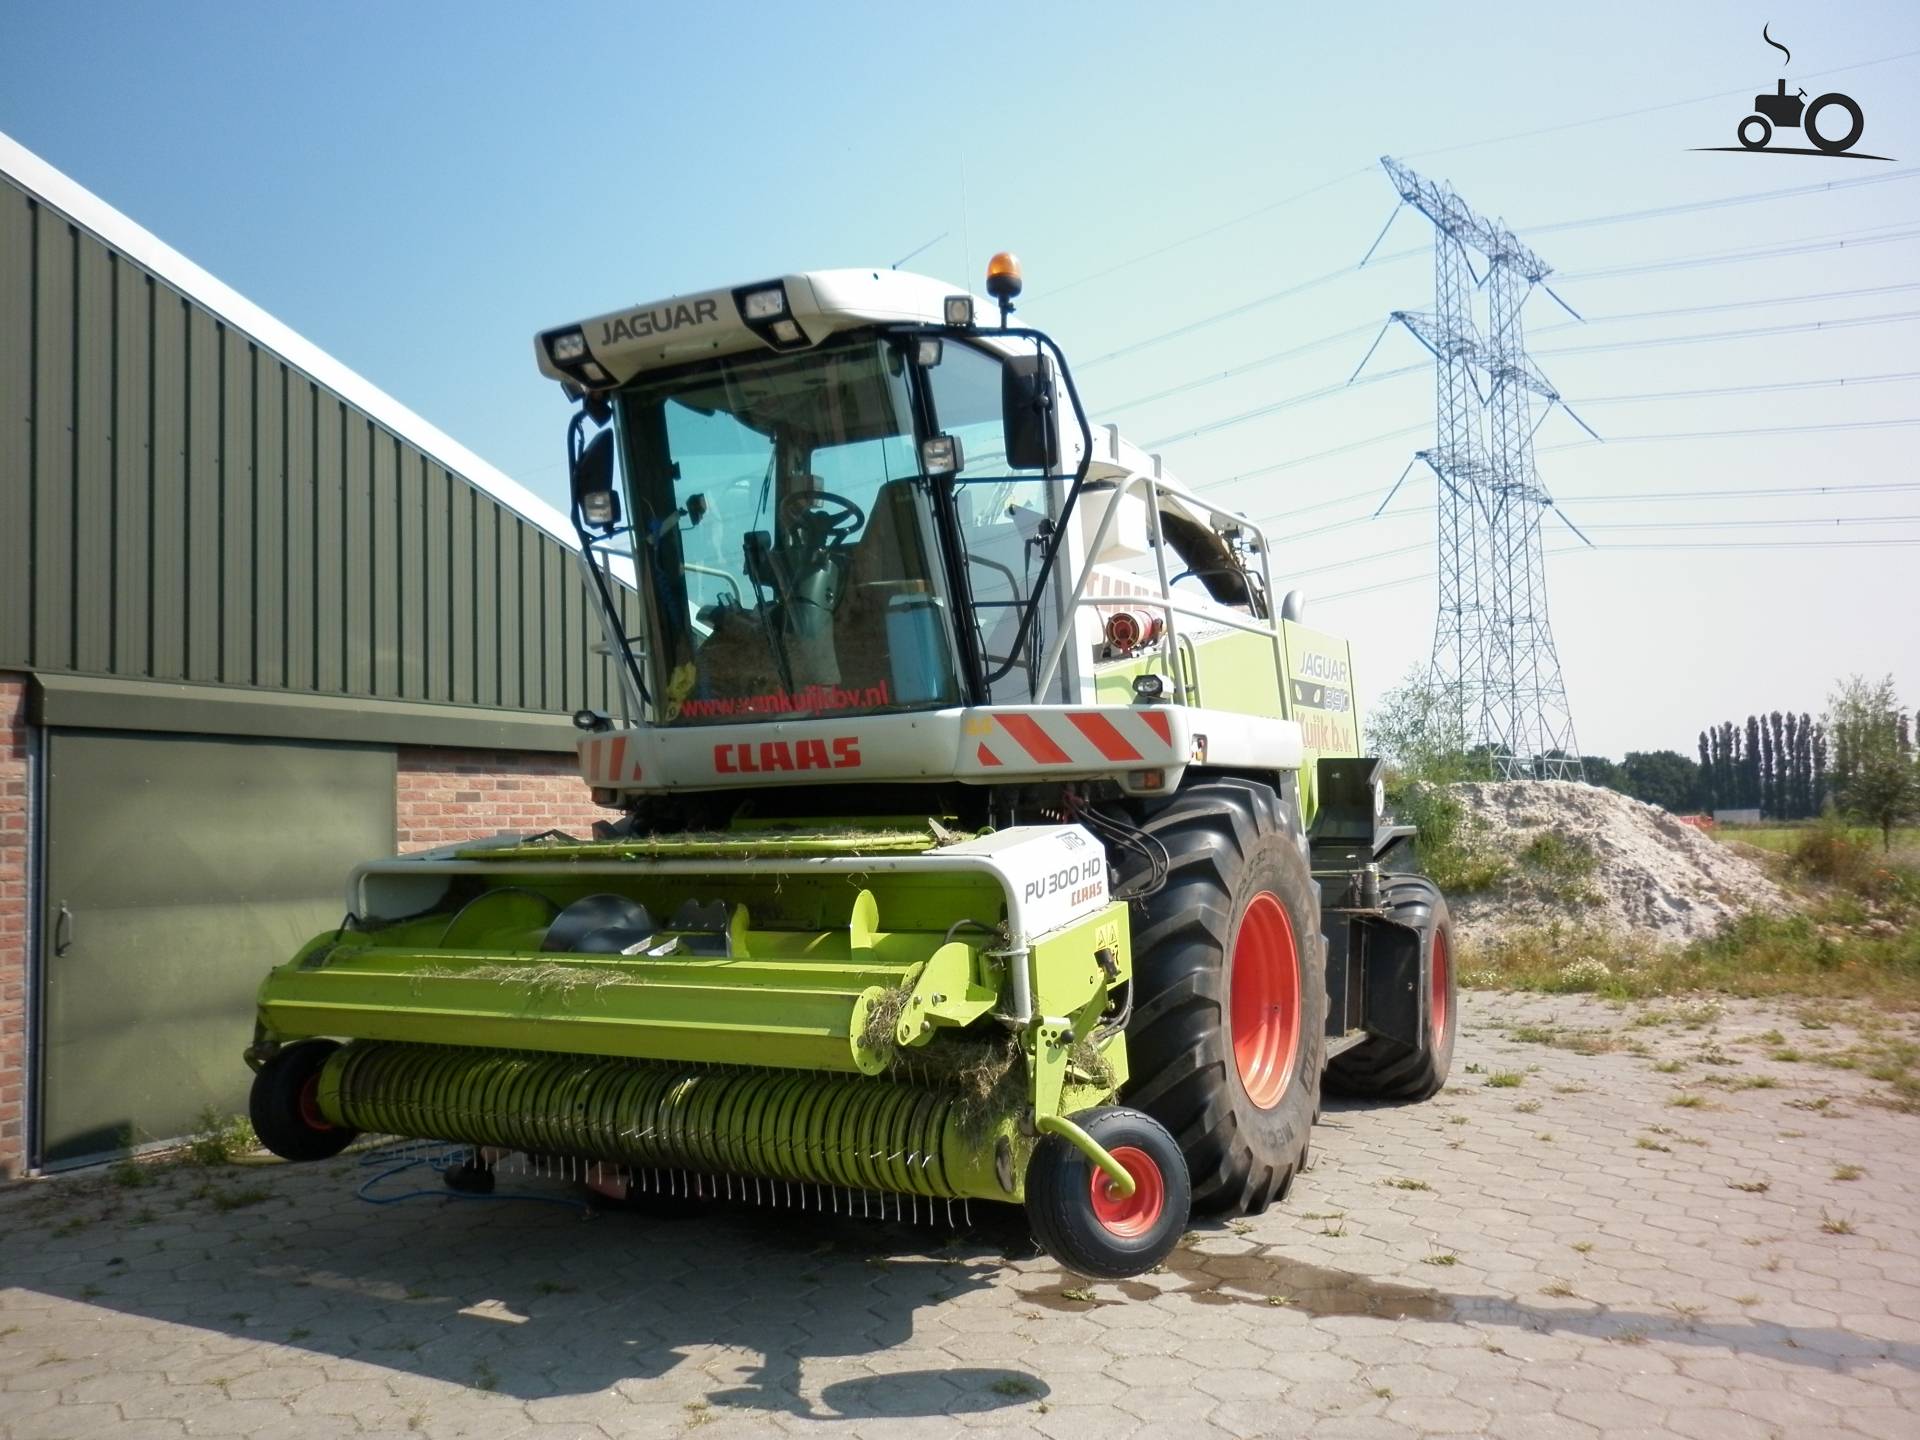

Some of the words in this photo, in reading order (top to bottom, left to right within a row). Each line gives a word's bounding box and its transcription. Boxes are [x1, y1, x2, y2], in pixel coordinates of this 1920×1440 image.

[601, 299, 719, 346] JAGUAR
[1300, 651, 1347, 682] JAGUAR
[713, 736, 862, 774] CLAAS
[1025, 877, 1046, 904] PU
[1048, 865, 1079, 894] 300
[1082, 857, 1101, 880] HD
[1071, 880, 1102, 907] CLAAS
